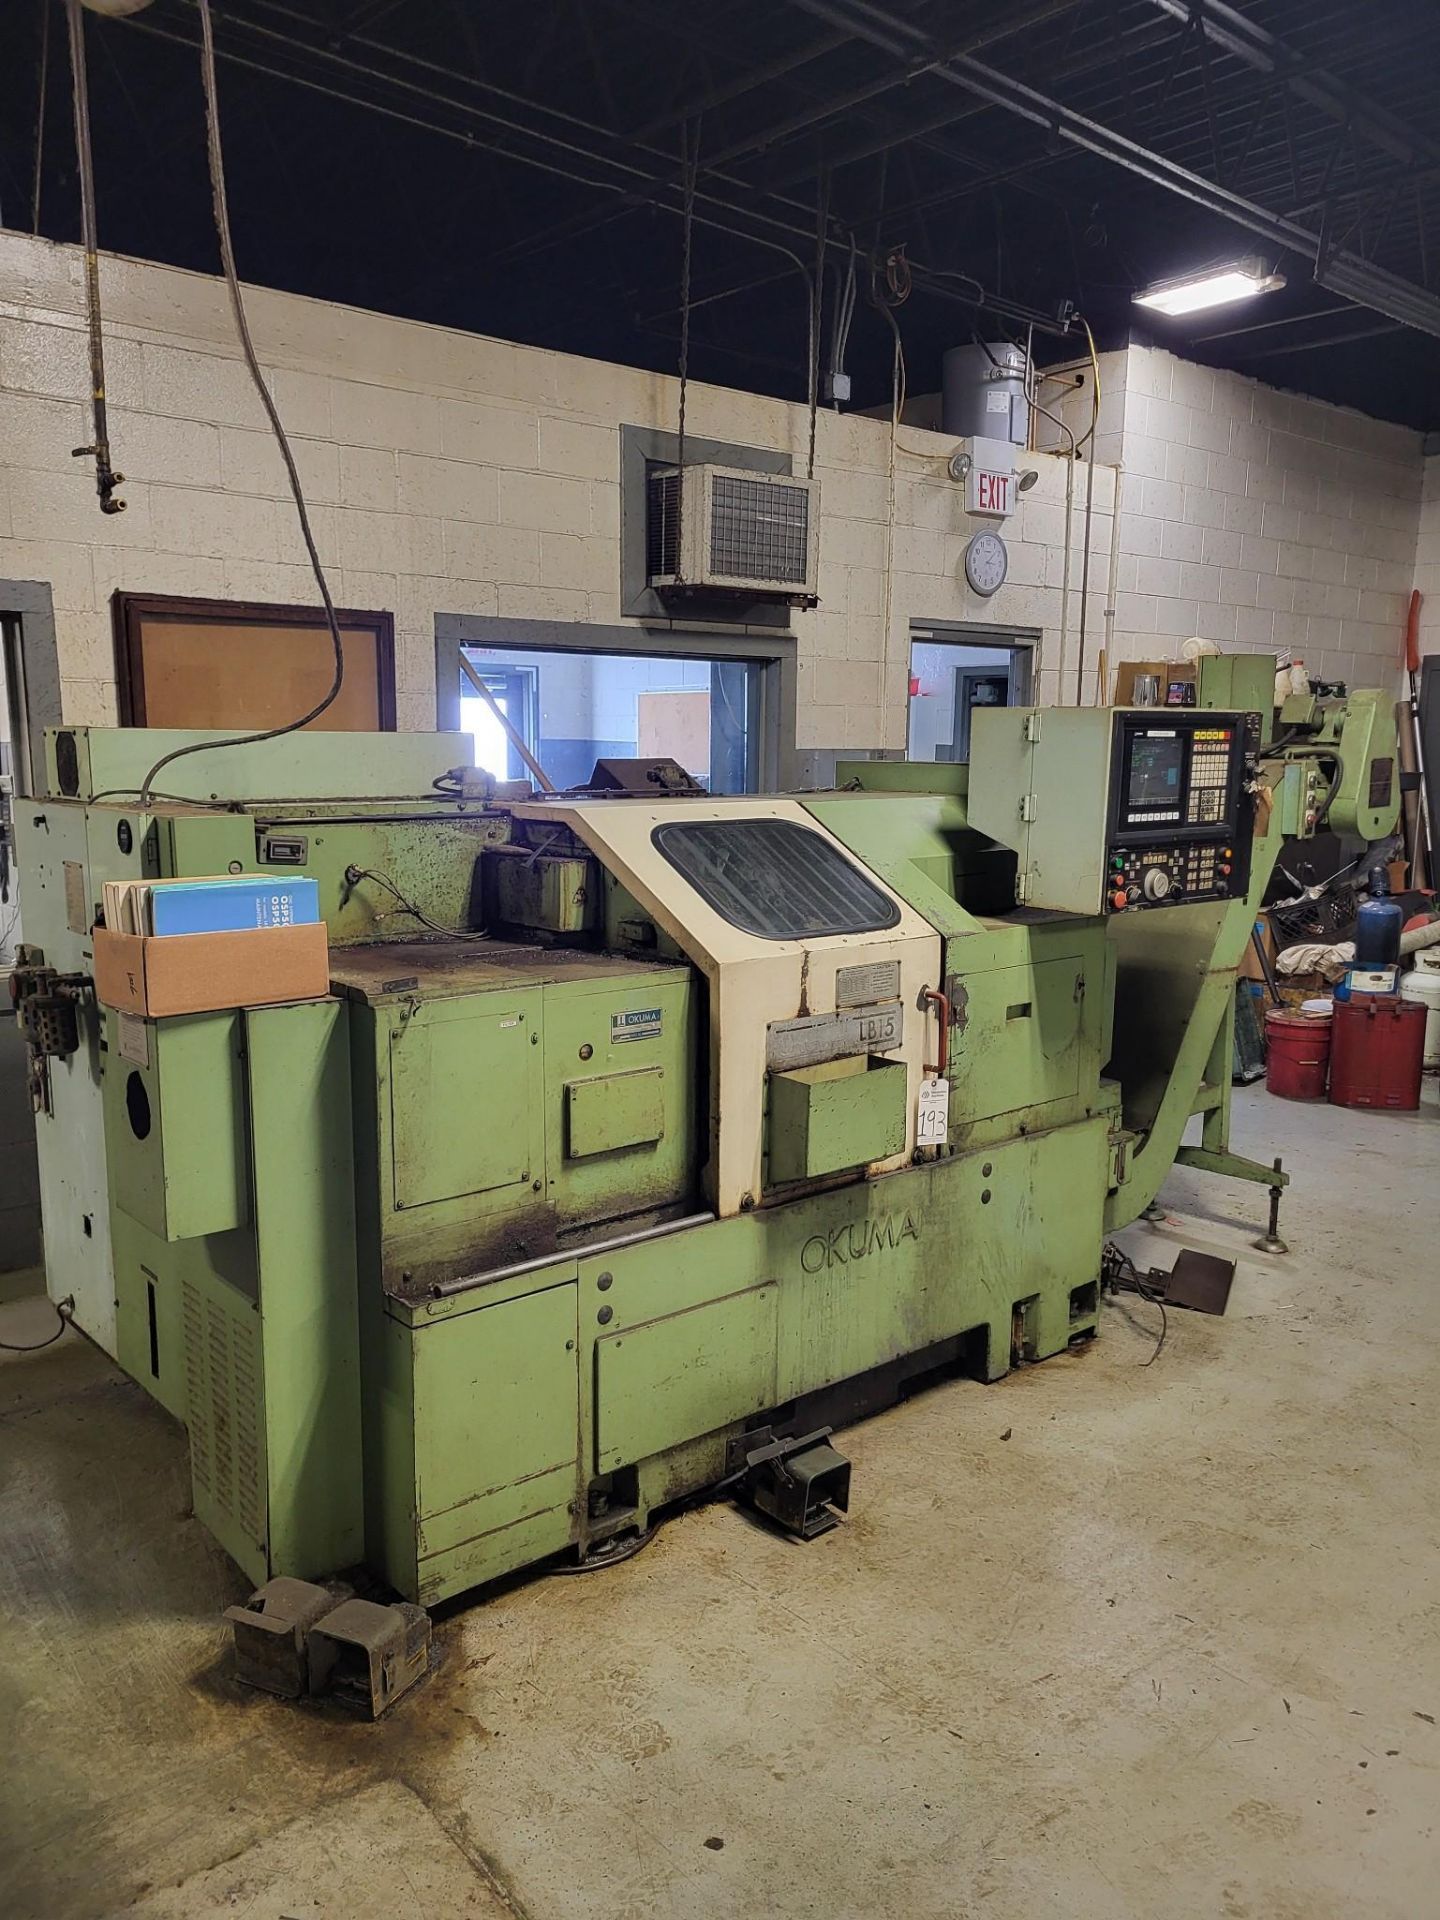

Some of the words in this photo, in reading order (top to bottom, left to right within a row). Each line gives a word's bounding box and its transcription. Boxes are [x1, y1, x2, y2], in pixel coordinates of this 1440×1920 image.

[979, 473, 1009, 511] EXIT
[628, 1011, 657, 1024] OKUMA
[859, 1016, 895, 1041] LB15
[918, 1110, 946, 1137] 193
[801, 1207, 919, 1273] OKUMA
